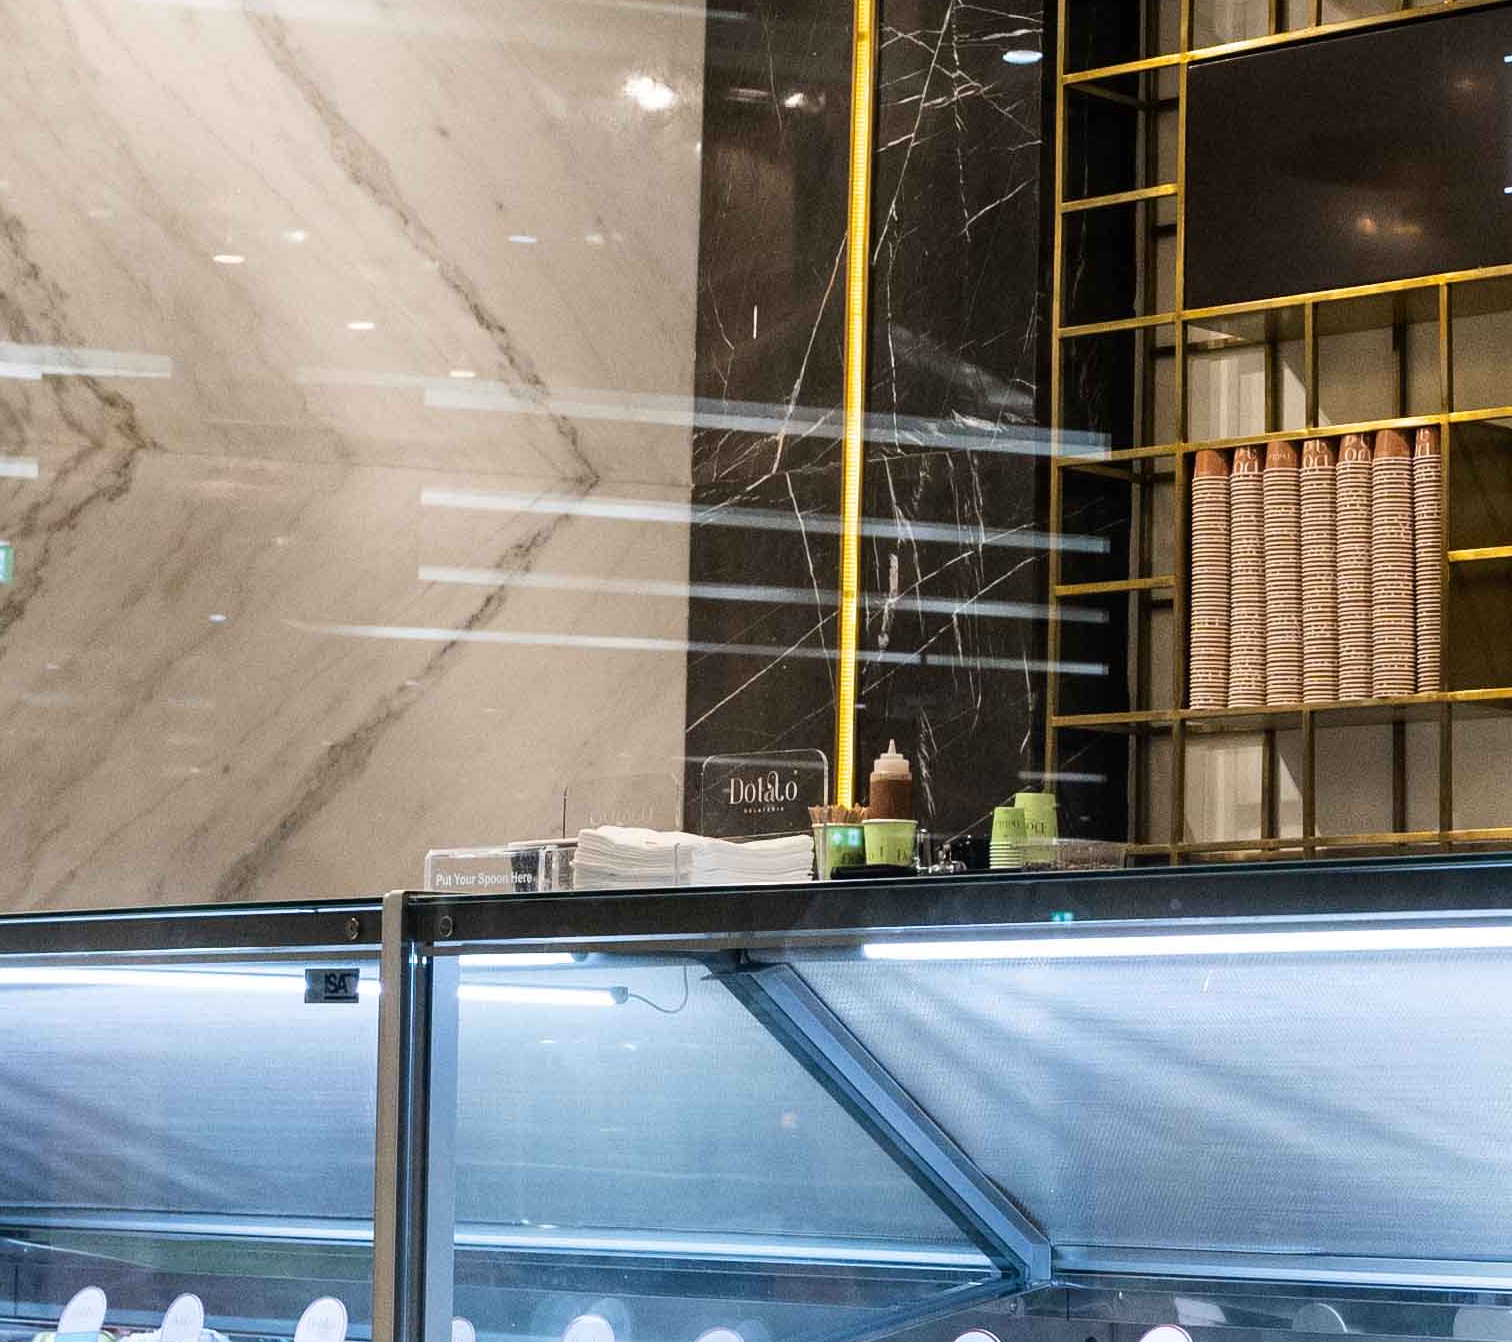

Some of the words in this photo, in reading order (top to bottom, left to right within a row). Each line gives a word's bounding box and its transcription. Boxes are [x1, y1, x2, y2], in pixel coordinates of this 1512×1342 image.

[729, 770, 798, 805] Dolato
[436, 873, 452, 886] Put
[454, 872, 476, 885] Your
[478, 872, 508, 888] Spoon
[324, 972, 349, 995] ISA
